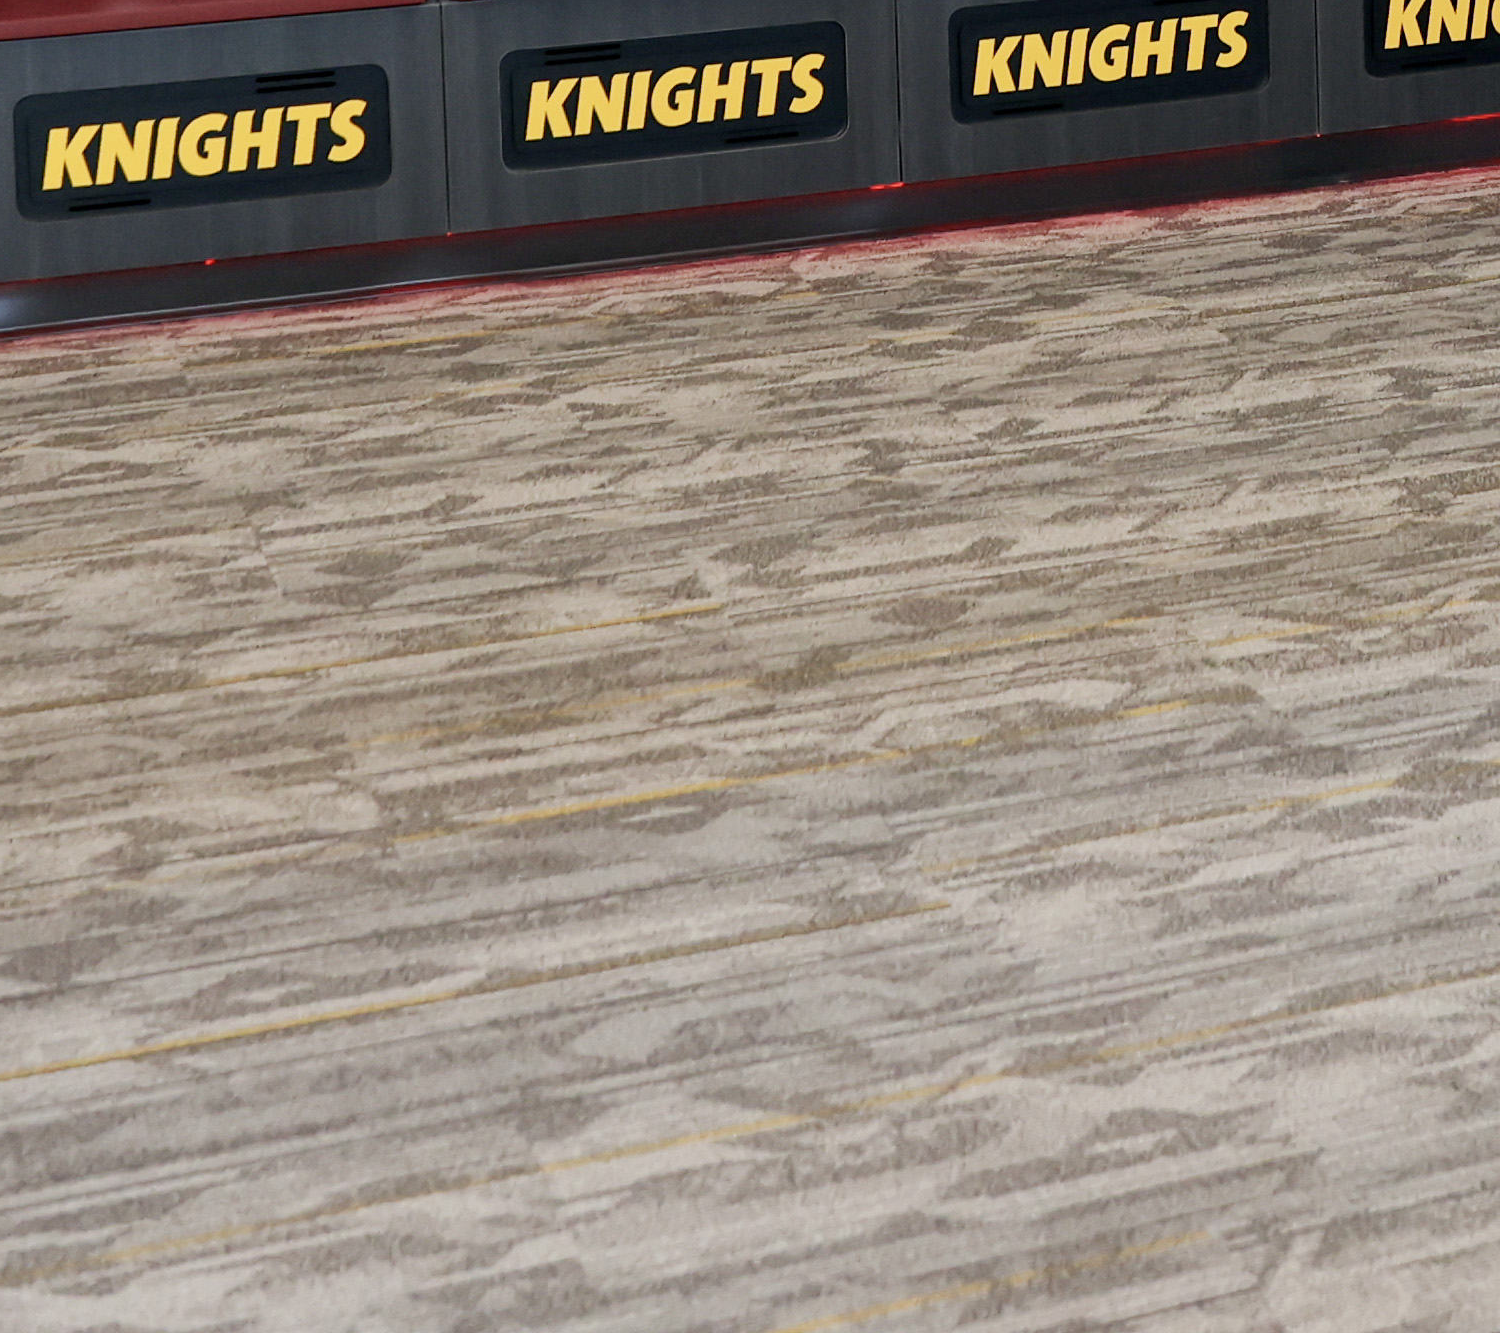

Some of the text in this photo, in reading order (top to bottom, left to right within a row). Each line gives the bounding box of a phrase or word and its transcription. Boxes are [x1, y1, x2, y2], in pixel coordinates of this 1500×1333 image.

[973, 7, 1249, 96] KNIGHTS
[525, 53, 825, 141] KNIGHTS
[42, 99, 366, 191] KNIGHTS
